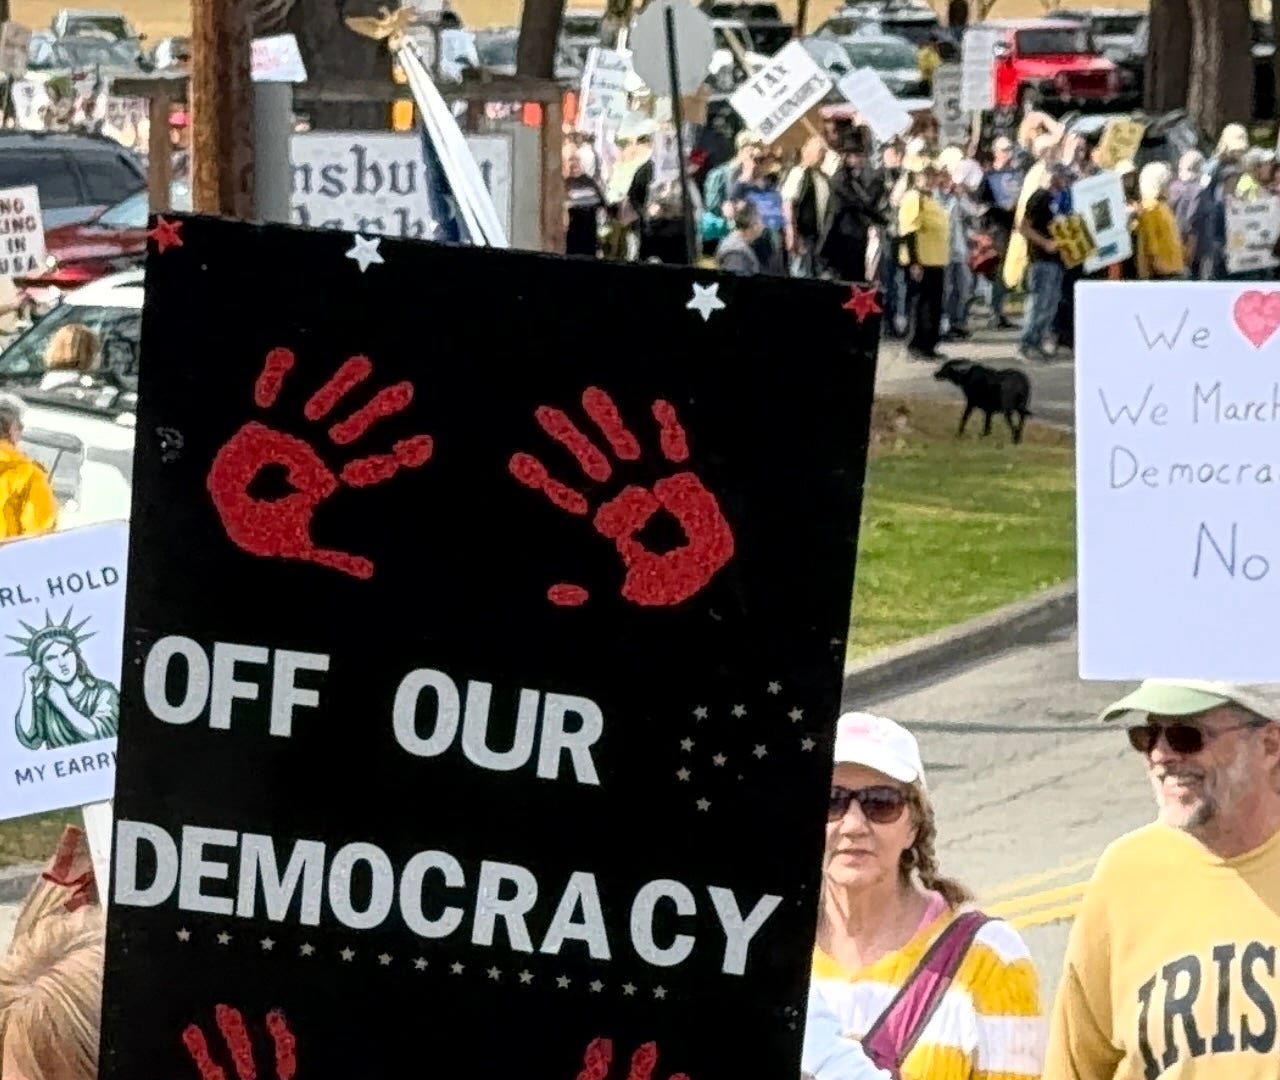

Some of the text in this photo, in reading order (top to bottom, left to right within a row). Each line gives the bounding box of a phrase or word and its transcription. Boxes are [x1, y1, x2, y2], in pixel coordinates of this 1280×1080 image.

[7, 236, 26, 255] IN
[1135, 308, 1211, 350] We
[1098, 382, 1169, 426] We
[1192, 520, 1270, 581] No
[46, 565, 120, 599] HOLD
[142, 635, 605, 786] OFF OUR
[14, 764, 46, 787] MY
[115, 819, 784, 977] DEMOCRACY
